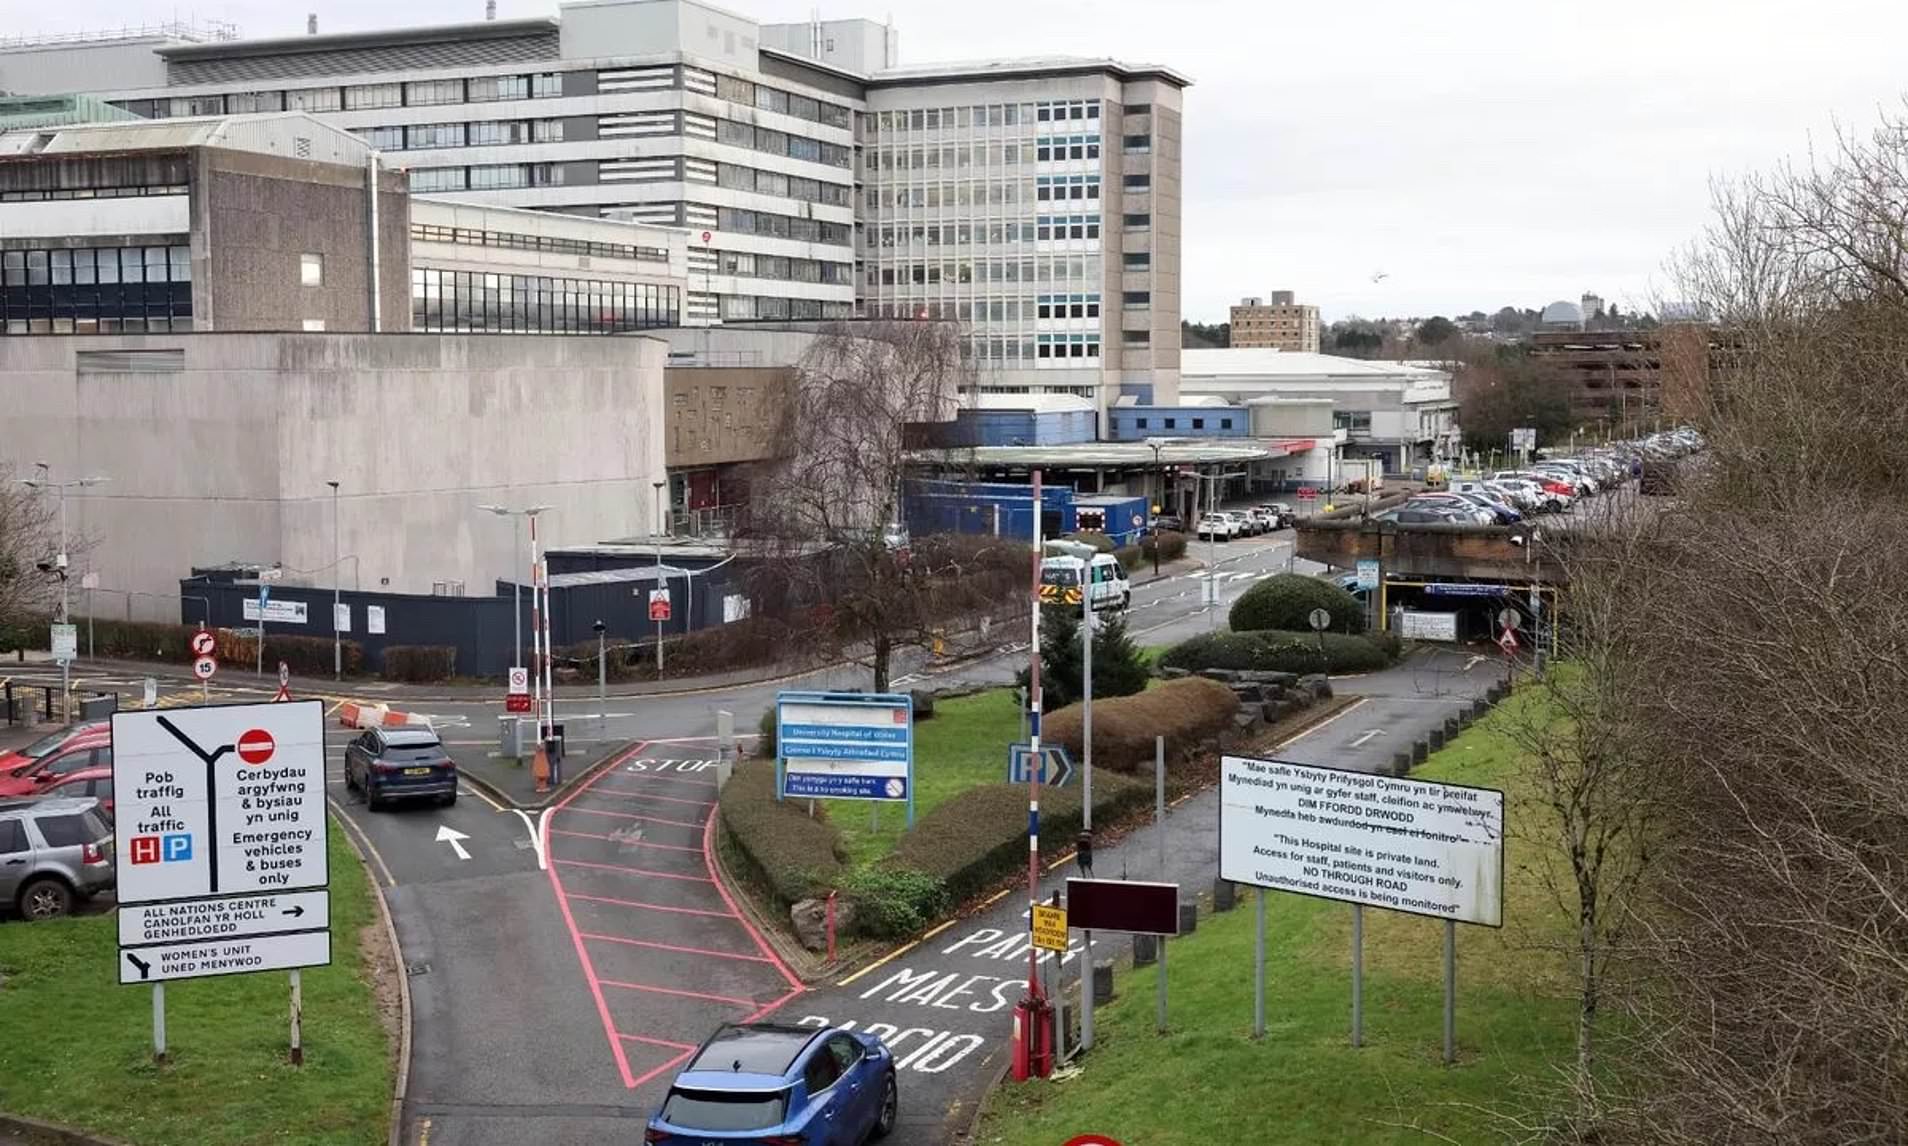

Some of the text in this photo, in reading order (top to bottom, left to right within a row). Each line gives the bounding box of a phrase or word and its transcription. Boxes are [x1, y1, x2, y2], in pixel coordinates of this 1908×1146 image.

[200, 662, 211, 673] 15
[145, 772, 174, 784] Pob
[236, 767, 306, 784] Cerbydau
[1268, 766, 1292, 776] safle
[1294, 768, 1327, 783] Ysbyty
[1330, 772, 1375, 788] Prifysgol
[1376, 779, 1411, 793] Cymru
[1413, 786, 1426, 796] yn
[1429, 786, 1440, 796] tir
[1443, 788, 1478, 802] preifat
[136, 785, 184, 799] traffig
[238, 782, 306, 798] argyfwng
[1276, 782, 1288, 791] yn
[1290, 784, 1312, 795] unig
[1326, 787, 1352, 799] gyfer
[1382, 794, 1420, 808] cleifion
[1422, 800, 1435, 810] ac
[242, 796, 302, 810] & bysiau
[1298, 798, 1414, 823] DIM FFORDD DRWODD
[150, 806, 172, 818] All
[246, 810, 300, 826] yn unig
[1298, 811, 1316, 822] heb
[1318, 816, 1368, 830] awdurdod
[138, 820, 184, 833] traffic
[233, 828, 312, 845] Emergency
[244, 844, 303, 858] vehicles
[1274, 834, 1440, 869] "This Hospital site is private land.
[246, 858, 302, 872] & buses
[1253, 846, 1464, 889] Access for staff, patients and visitors only.
[258, 873, 290, 886] only
[1303, 866, 1408, 892] NO THROUGH ROAD
[1255, 870, 1461, 913] Unauthorised access is being monitored"
[144, 898, 276, 918] ALL NATIONS CENTRE
[144, 910, 265, 929] CANOLFAN YR HOLL
[144, 924, 237, 940] GENHEDLOEDD
[161, 945, 251, 962] WOMEN'S UNIT
[162, 956, 262, 974] UNED MENYWOD
[859, 968, 1030, 1013] MAES
